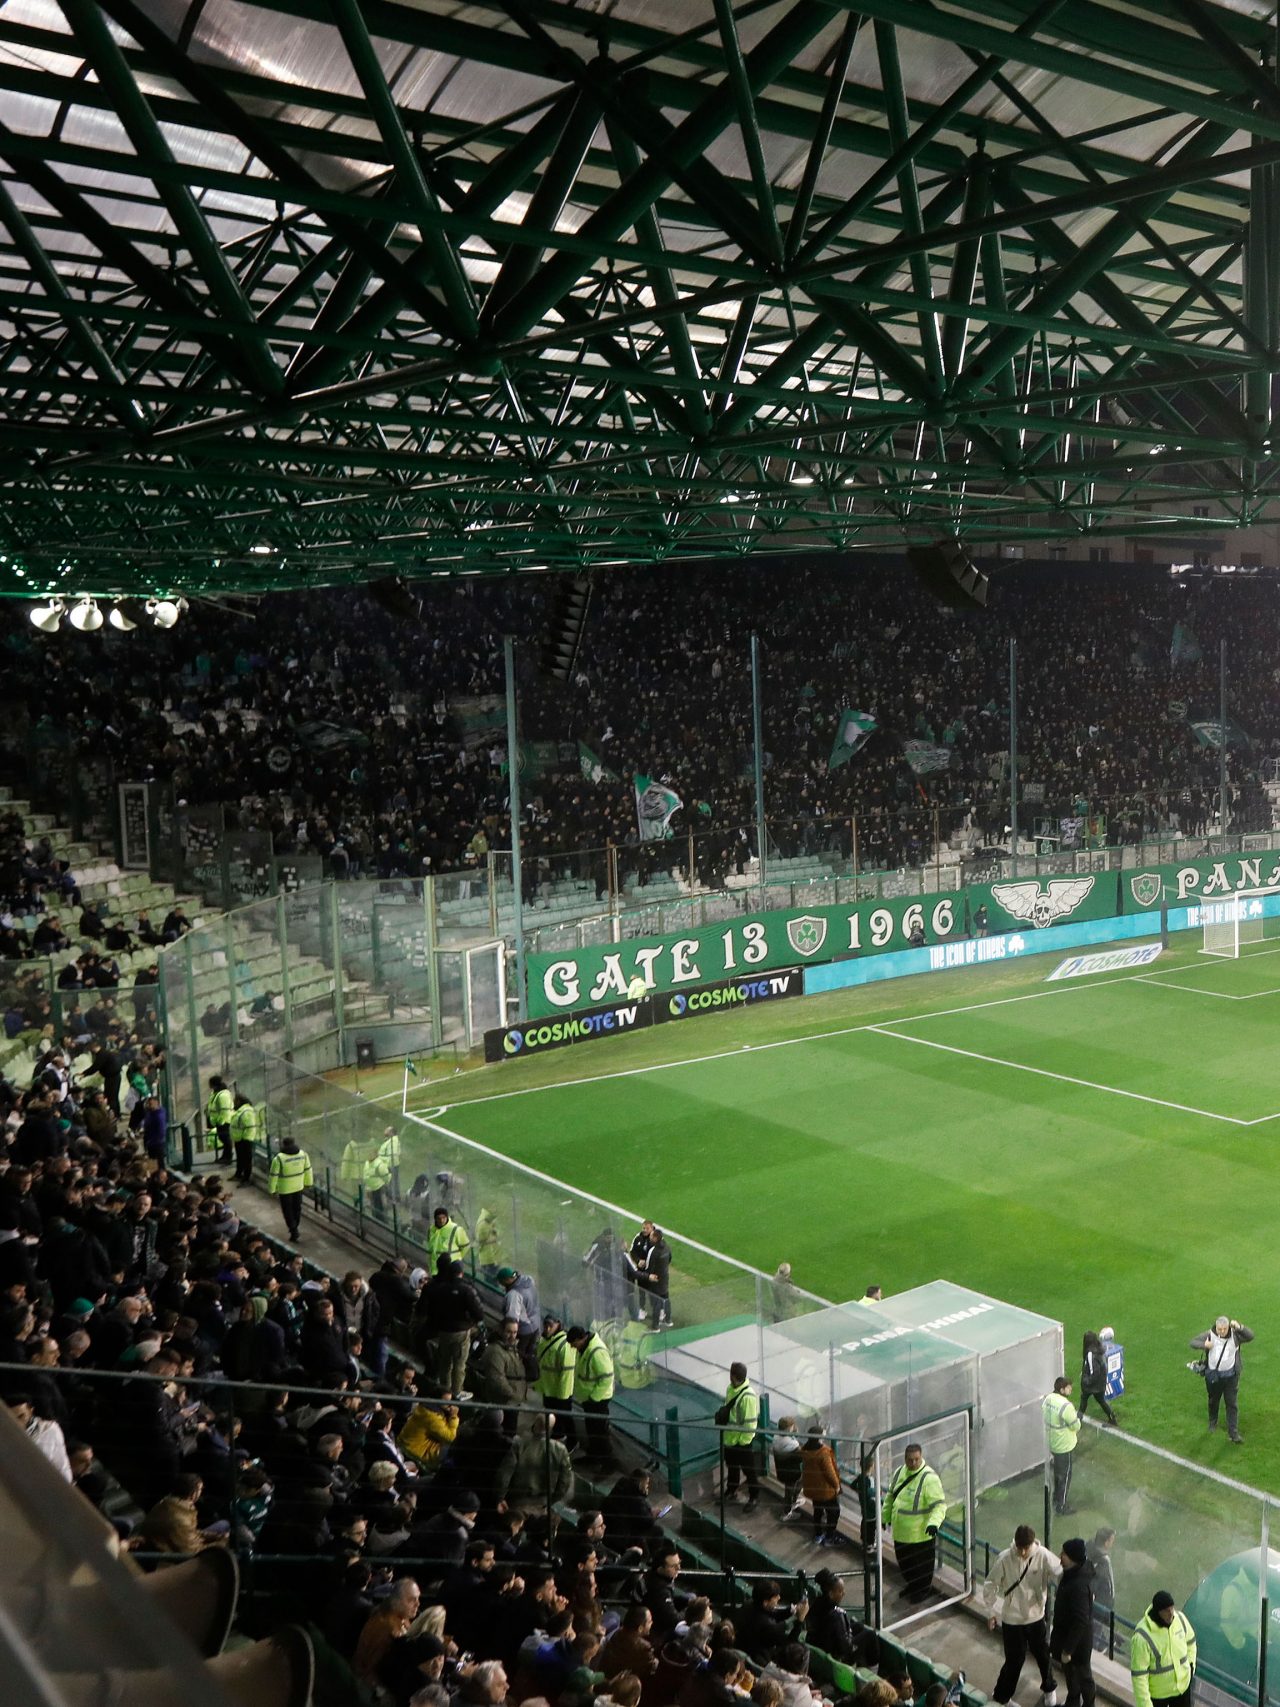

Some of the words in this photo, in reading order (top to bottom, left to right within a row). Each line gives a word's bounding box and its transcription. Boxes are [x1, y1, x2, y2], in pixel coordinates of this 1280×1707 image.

[544, 940, 700, 1006] GATE
[722, 922, 768, 970] 13
[847, 899, 954, 949] 1966
[1077, 947, 1159, 973] COSMOTE
